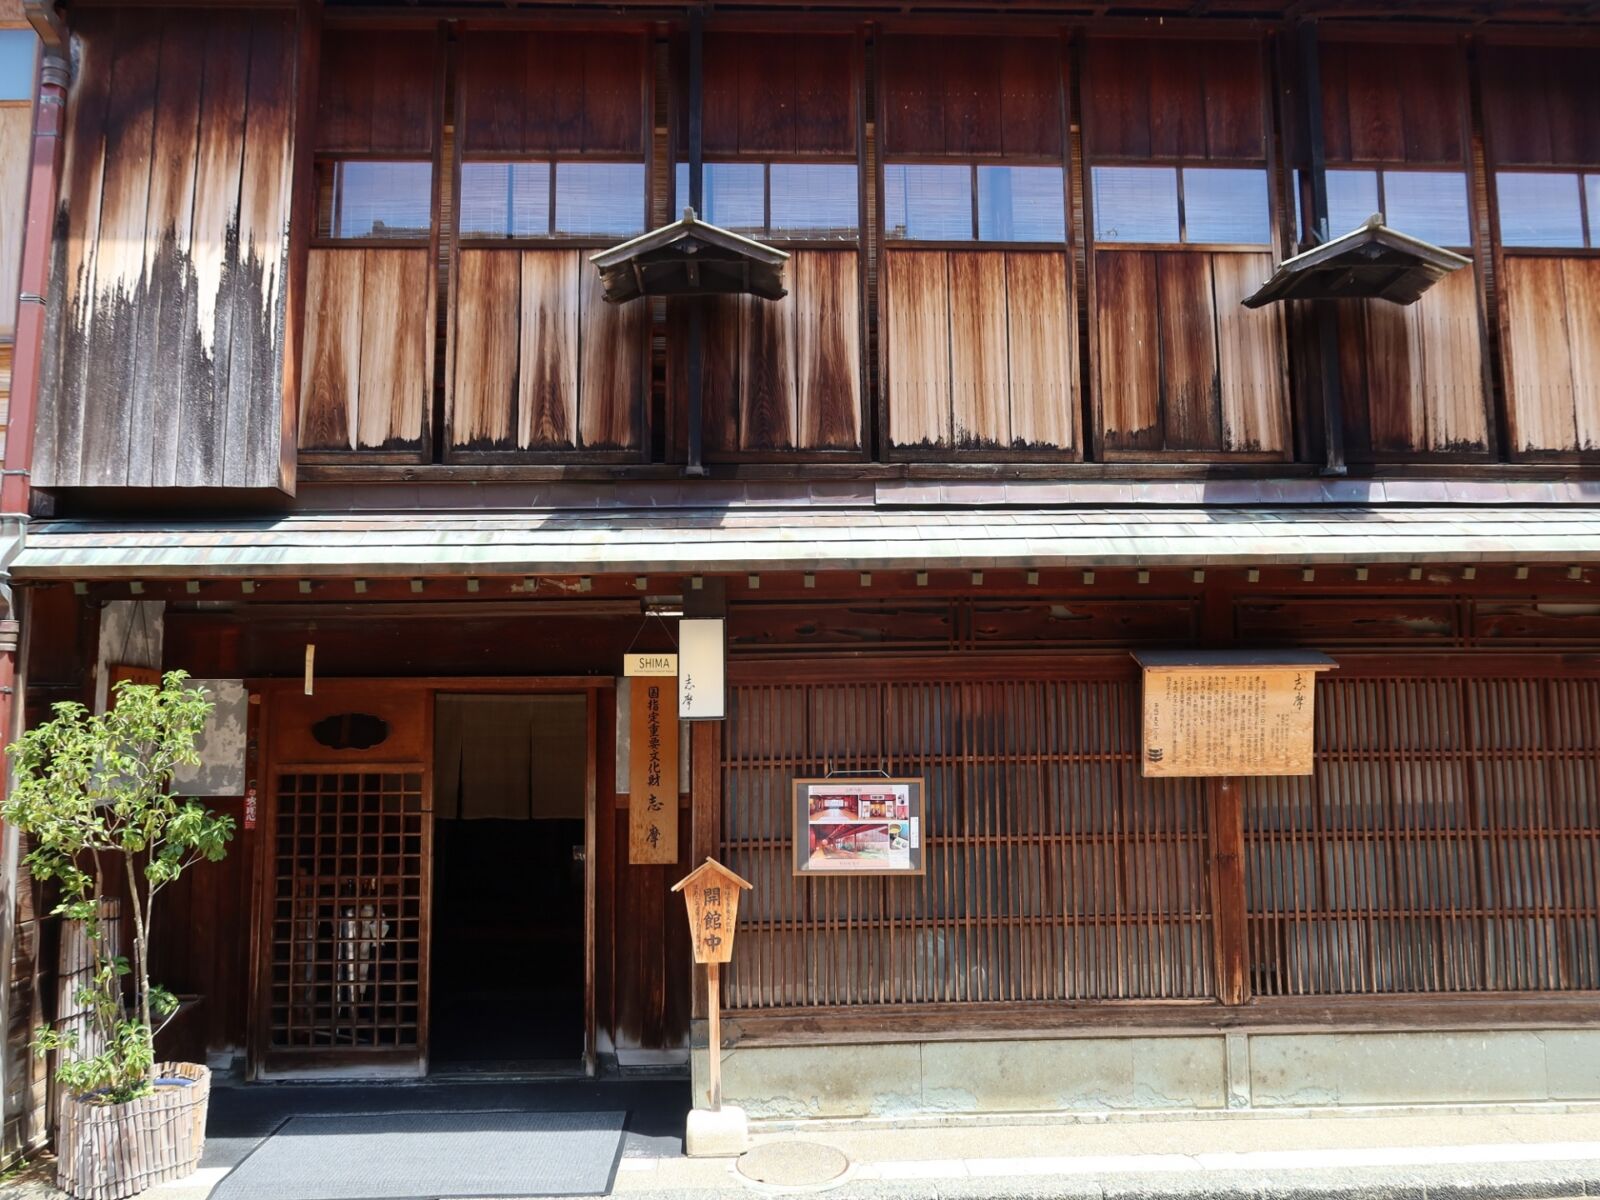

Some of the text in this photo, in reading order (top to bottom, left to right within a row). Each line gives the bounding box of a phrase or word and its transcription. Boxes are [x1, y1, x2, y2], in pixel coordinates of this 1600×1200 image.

[639, 657, 670, 669] SHIMA
[704, 886, 722, 953] 開館中
